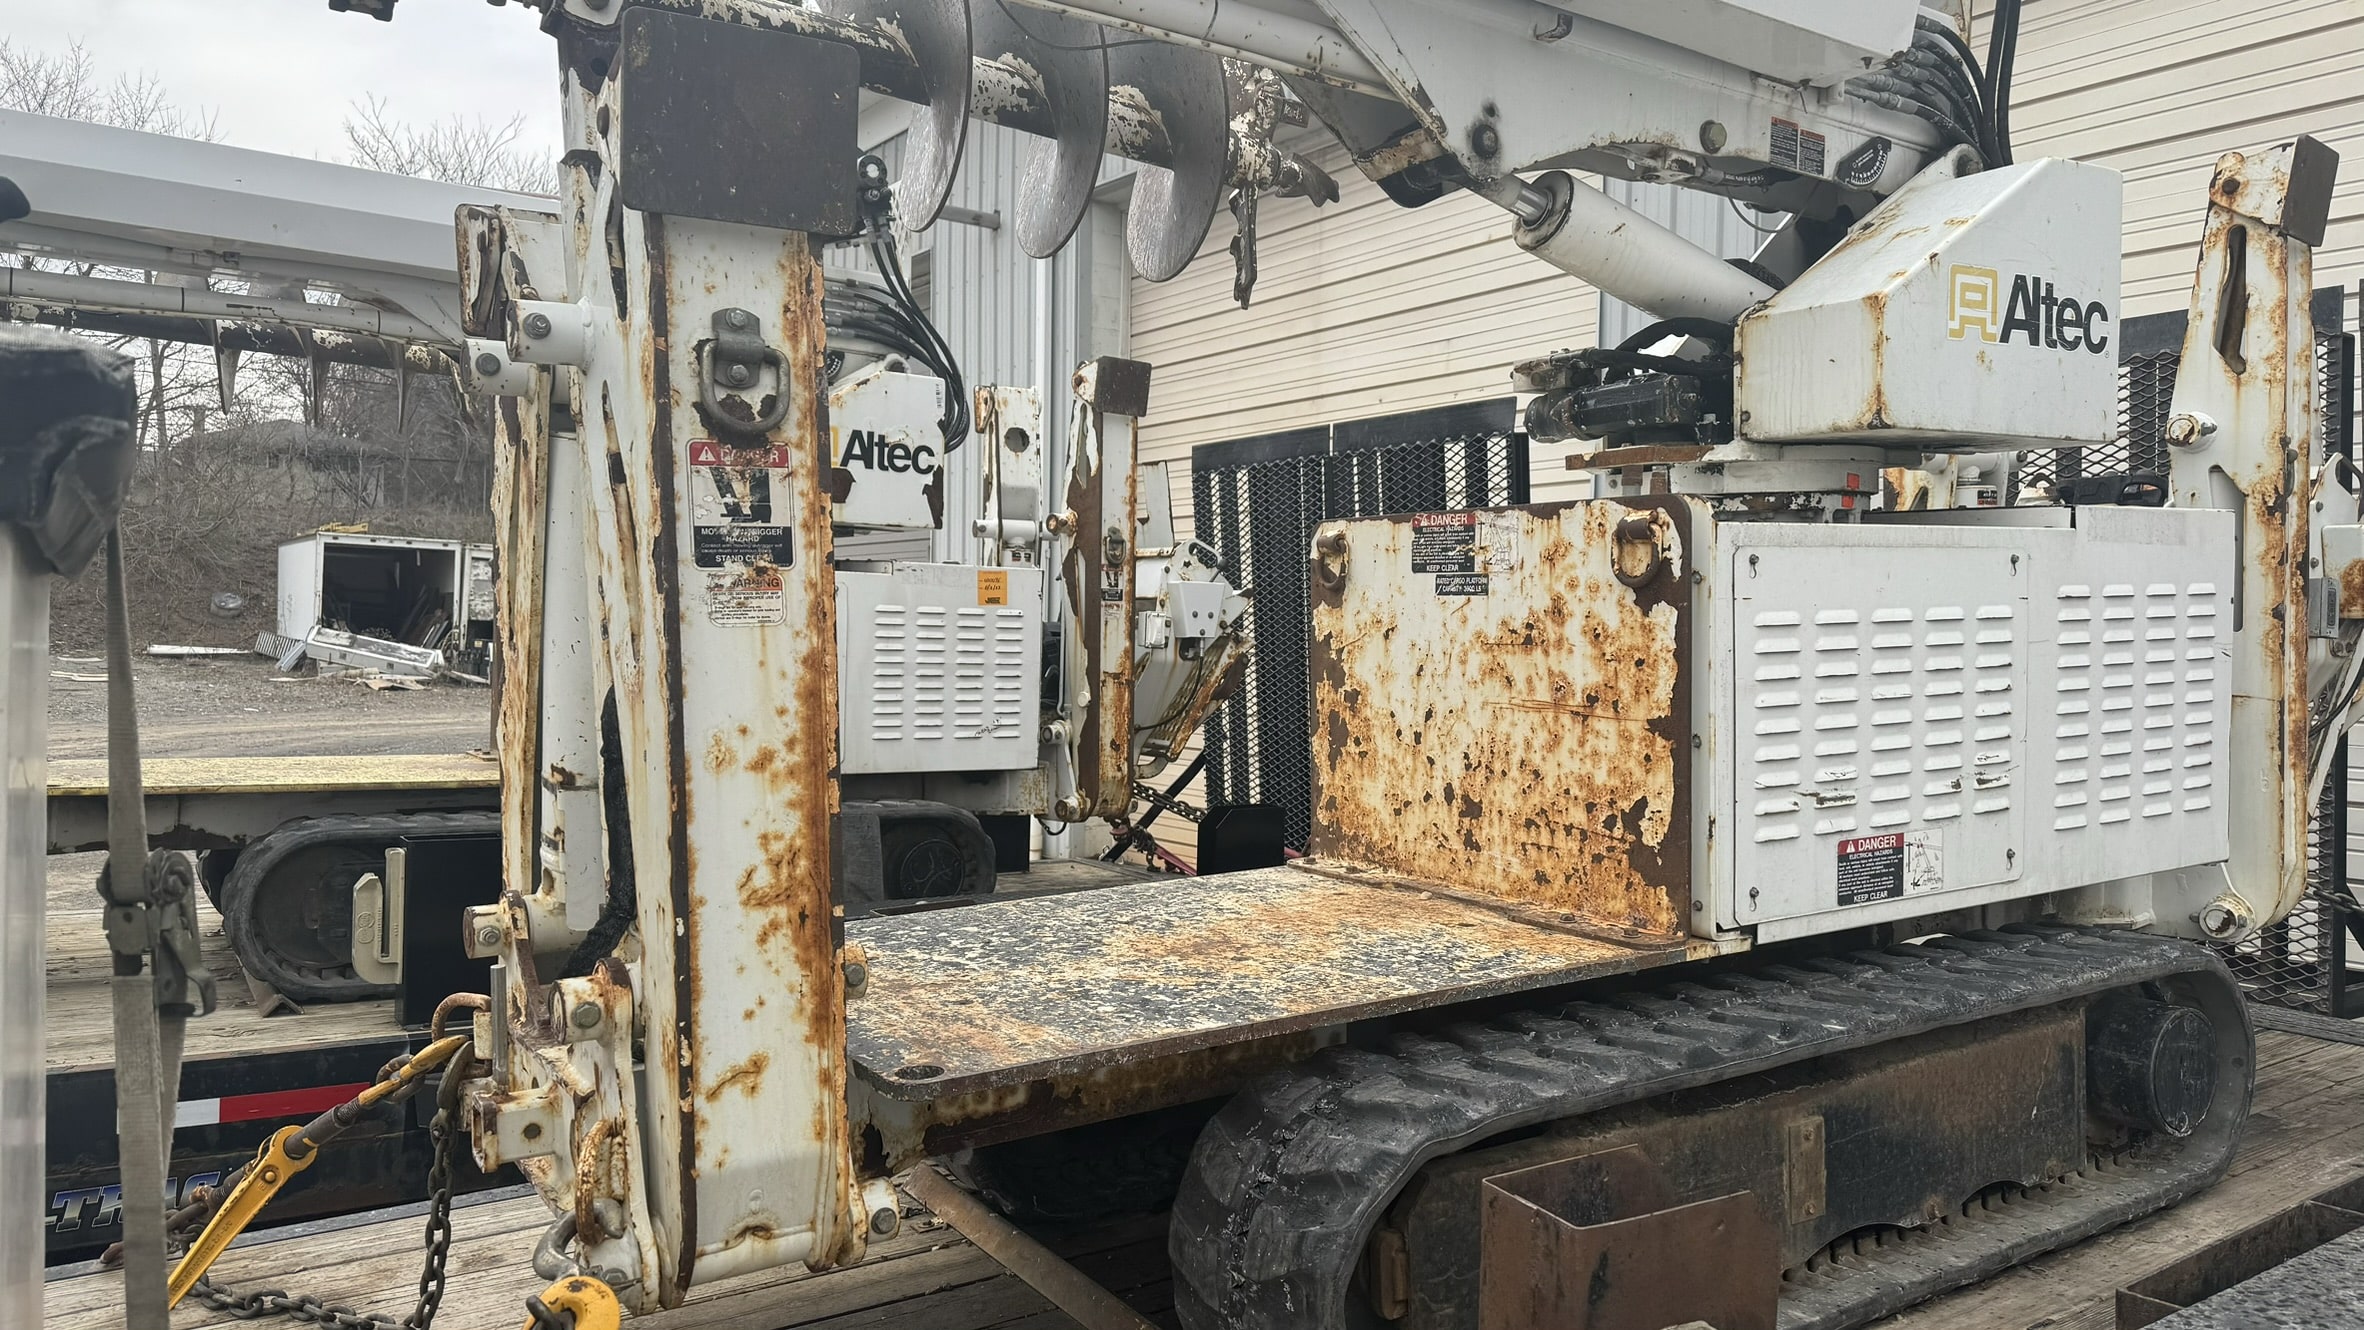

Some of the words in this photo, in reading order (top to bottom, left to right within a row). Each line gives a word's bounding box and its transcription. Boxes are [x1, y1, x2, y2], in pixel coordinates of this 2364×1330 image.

[1998, 273, 2109, 355] Altec
[839, 429, 935, 475] Altec
[1430, 513, 1468, 526] DANGER
[715, 554, 744, 562] STAND
[745, 554, 774, 562] CLE
[1858, 835, 1897, 852] DANGER
[1849, 852, 1874, 860] ELECTRICAL
[1873, 848, 1894, 857] HAZARDS
[1853, 892, 1869, 903] KEEP
[1870, 890, 1888, 900] CLEAR
